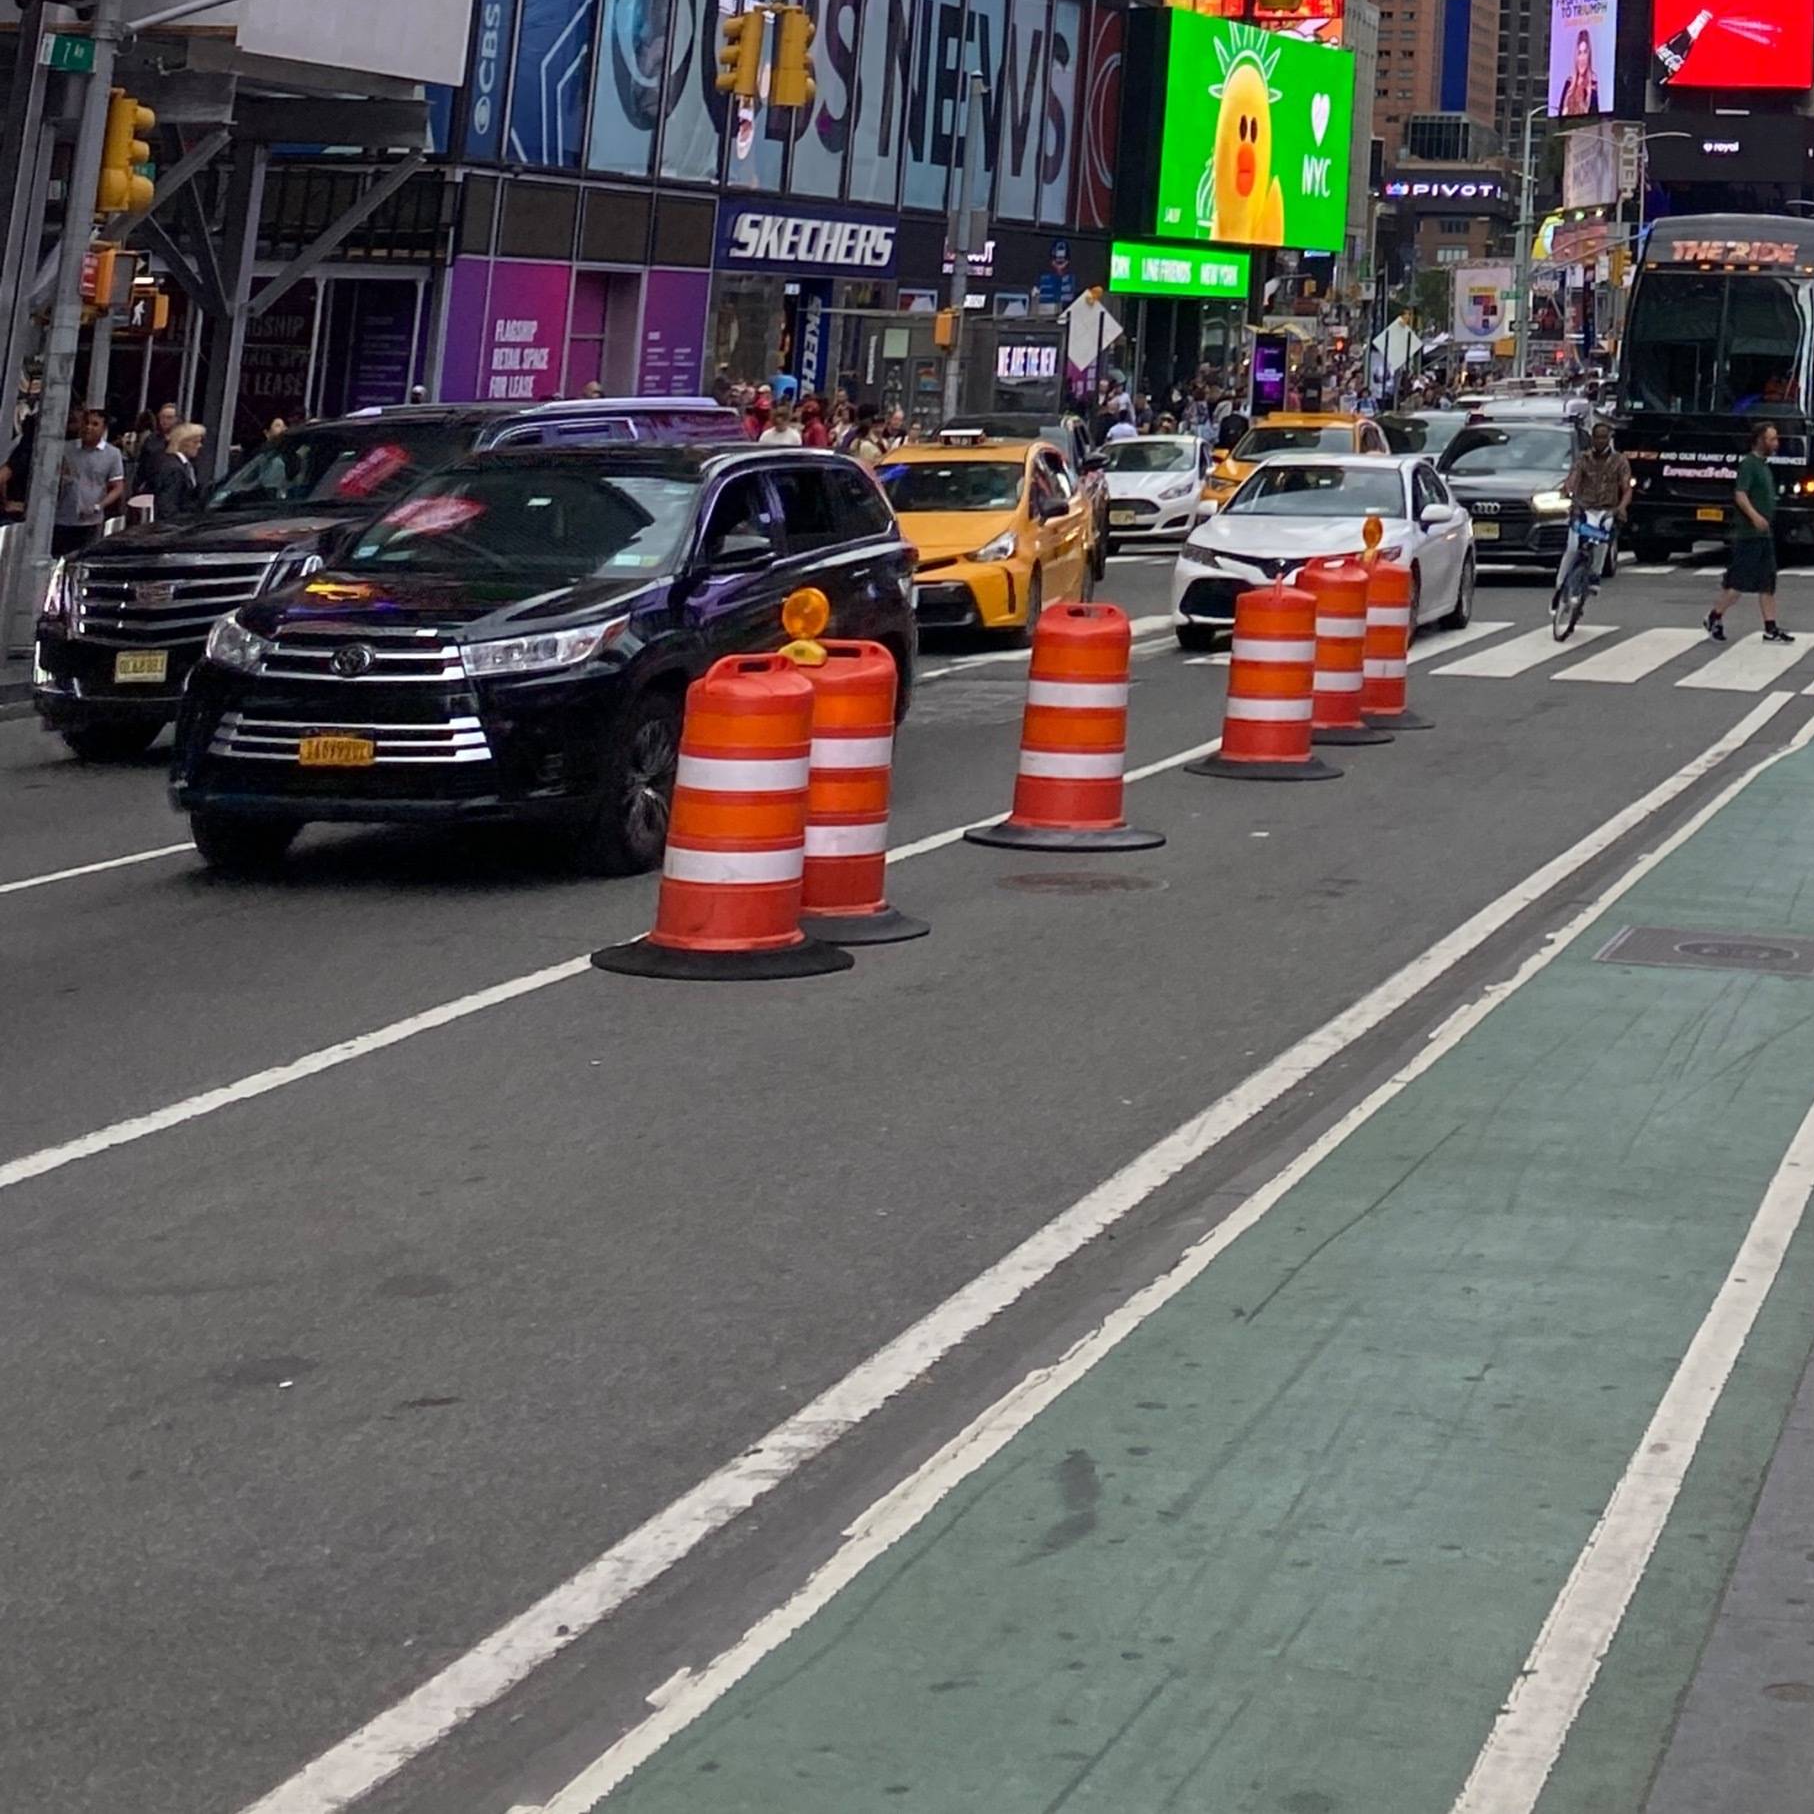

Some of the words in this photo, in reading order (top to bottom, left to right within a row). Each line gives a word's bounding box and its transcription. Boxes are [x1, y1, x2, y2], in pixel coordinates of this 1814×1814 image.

[478, 2, 501, 94] CBS
[1713, 141, 1739, 153] royal
[1301, 154, 1332, 198] NYC
[1412, 184, 1494, 198] PIVOT
[729, 213, 896, 267] SKECHERS
[1672, 241, 1725, 261] THE
[1726, 241, 1799, 263] RIDE
[801, 295, 823, 396] SKECH
[1659, 451, 1678, 461] AND
[1679, 452, 1696, 461] OUR
